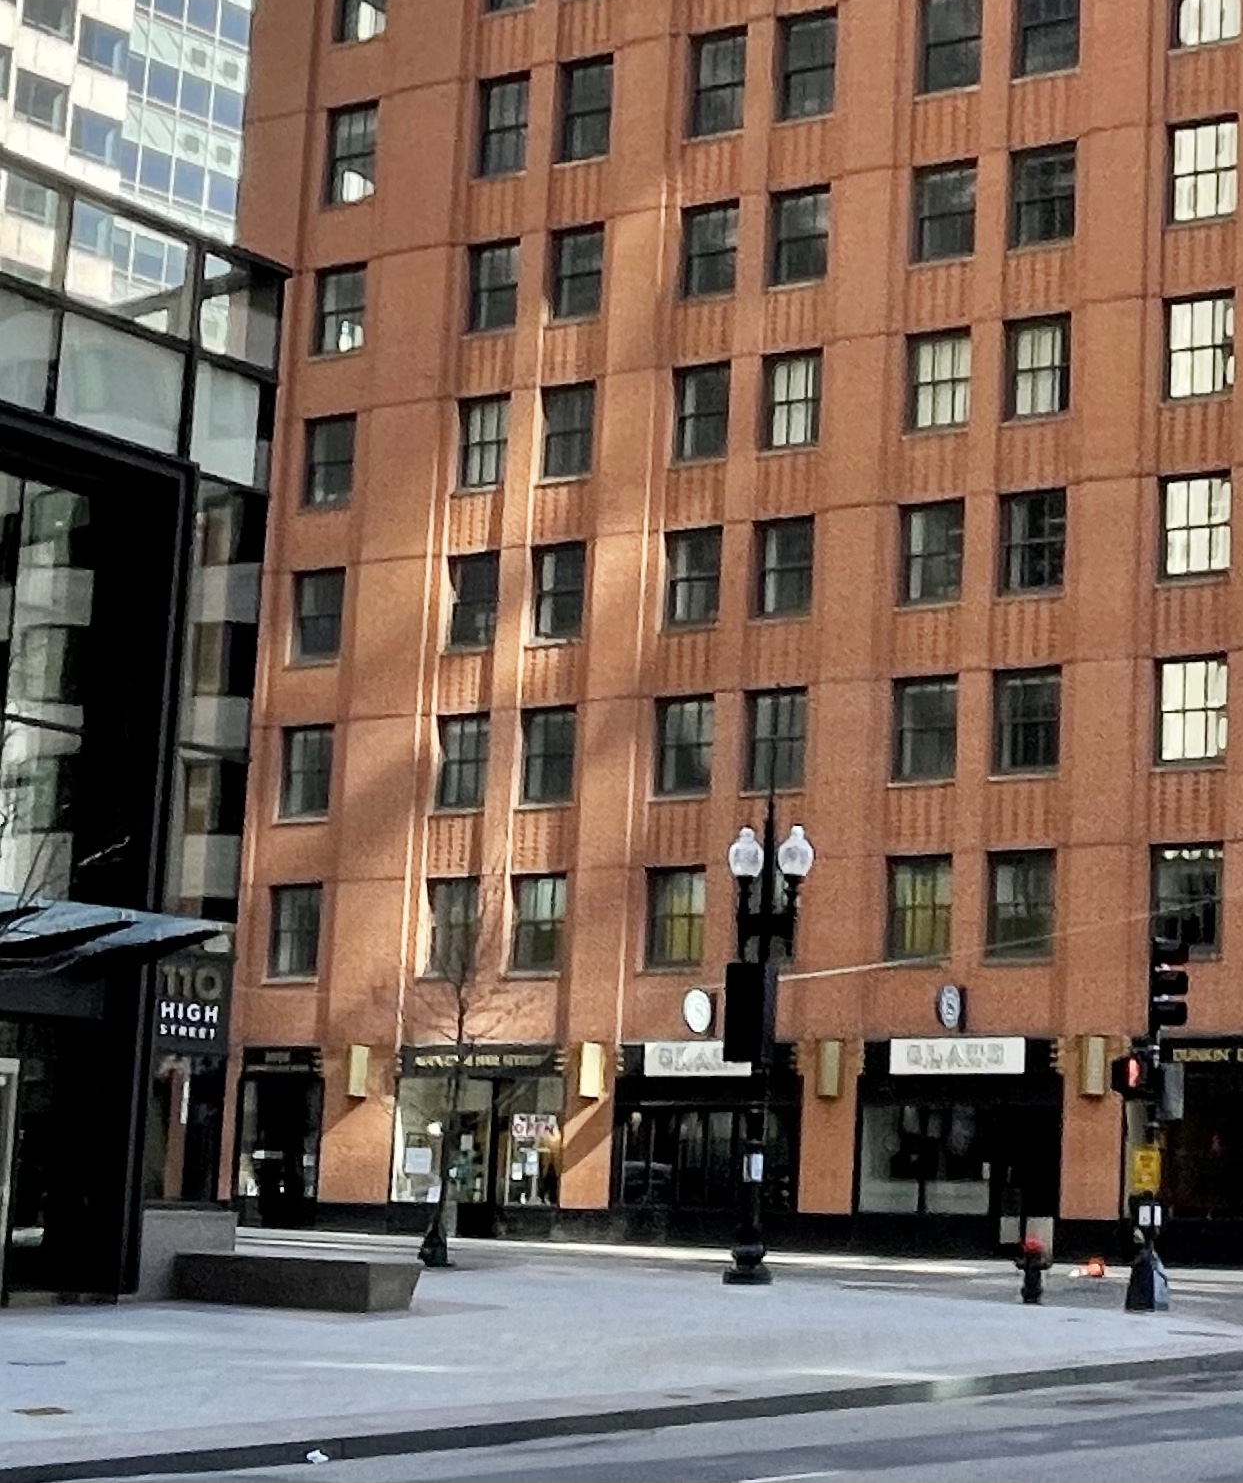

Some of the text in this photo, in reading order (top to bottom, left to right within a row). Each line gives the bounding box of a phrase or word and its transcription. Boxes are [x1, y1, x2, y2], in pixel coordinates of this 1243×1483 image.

[162, 965, 222, 1000] 110
[160, 1001, 219, 1024] HIGH
[160, 1023, 216, 1040] STREET
[513, 1122, 555, 1137] OPEN
